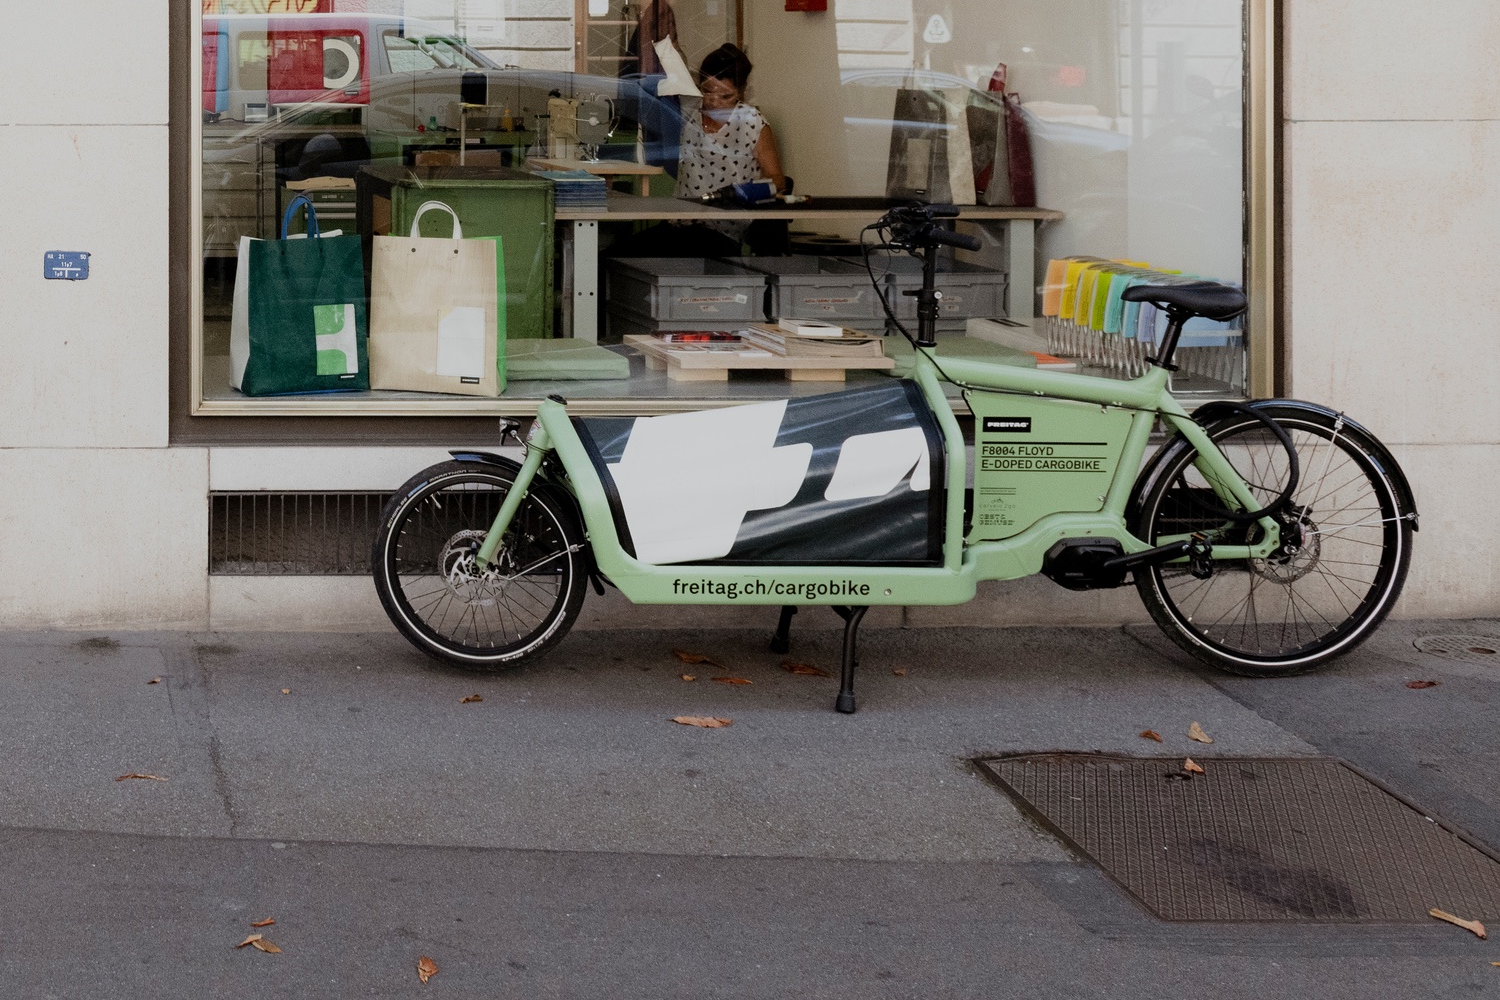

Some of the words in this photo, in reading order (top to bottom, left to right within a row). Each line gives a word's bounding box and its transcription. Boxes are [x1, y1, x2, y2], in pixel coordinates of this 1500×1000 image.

[982, 446, 1015, 456] F8004
[1018, 446, 1054, 456] FLOYD
[982, 460, 1032, 469] E-DOPED
[1035, 460, 1100, 470] CARGOBIKE
[672, 578, 870, 600] freitag.ch/cargobike
